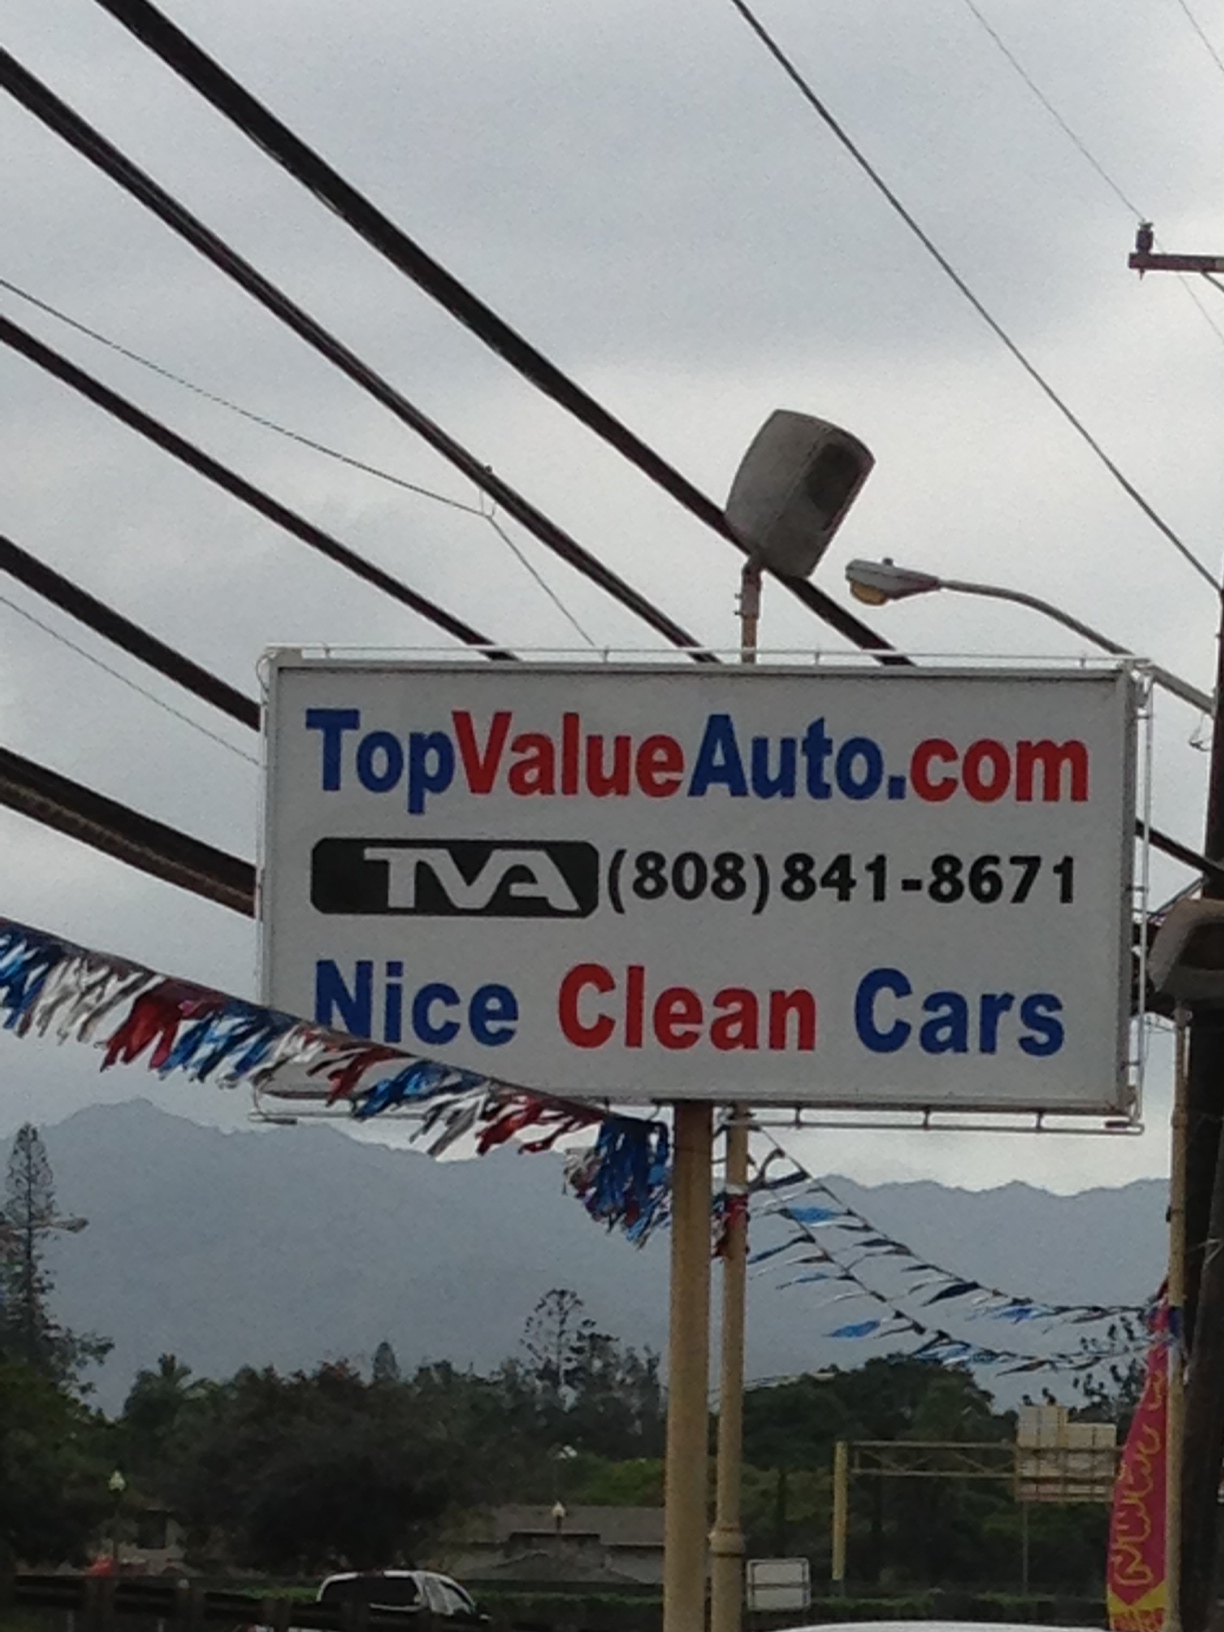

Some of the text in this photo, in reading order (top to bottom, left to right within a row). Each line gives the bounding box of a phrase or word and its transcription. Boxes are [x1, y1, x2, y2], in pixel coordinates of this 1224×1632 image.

[306, 708, 1090, 815] TopValueAuto.com
[363, 847, 583, 913] TVA
[314, 959, 1065, 1057] Nice Clean Cars
